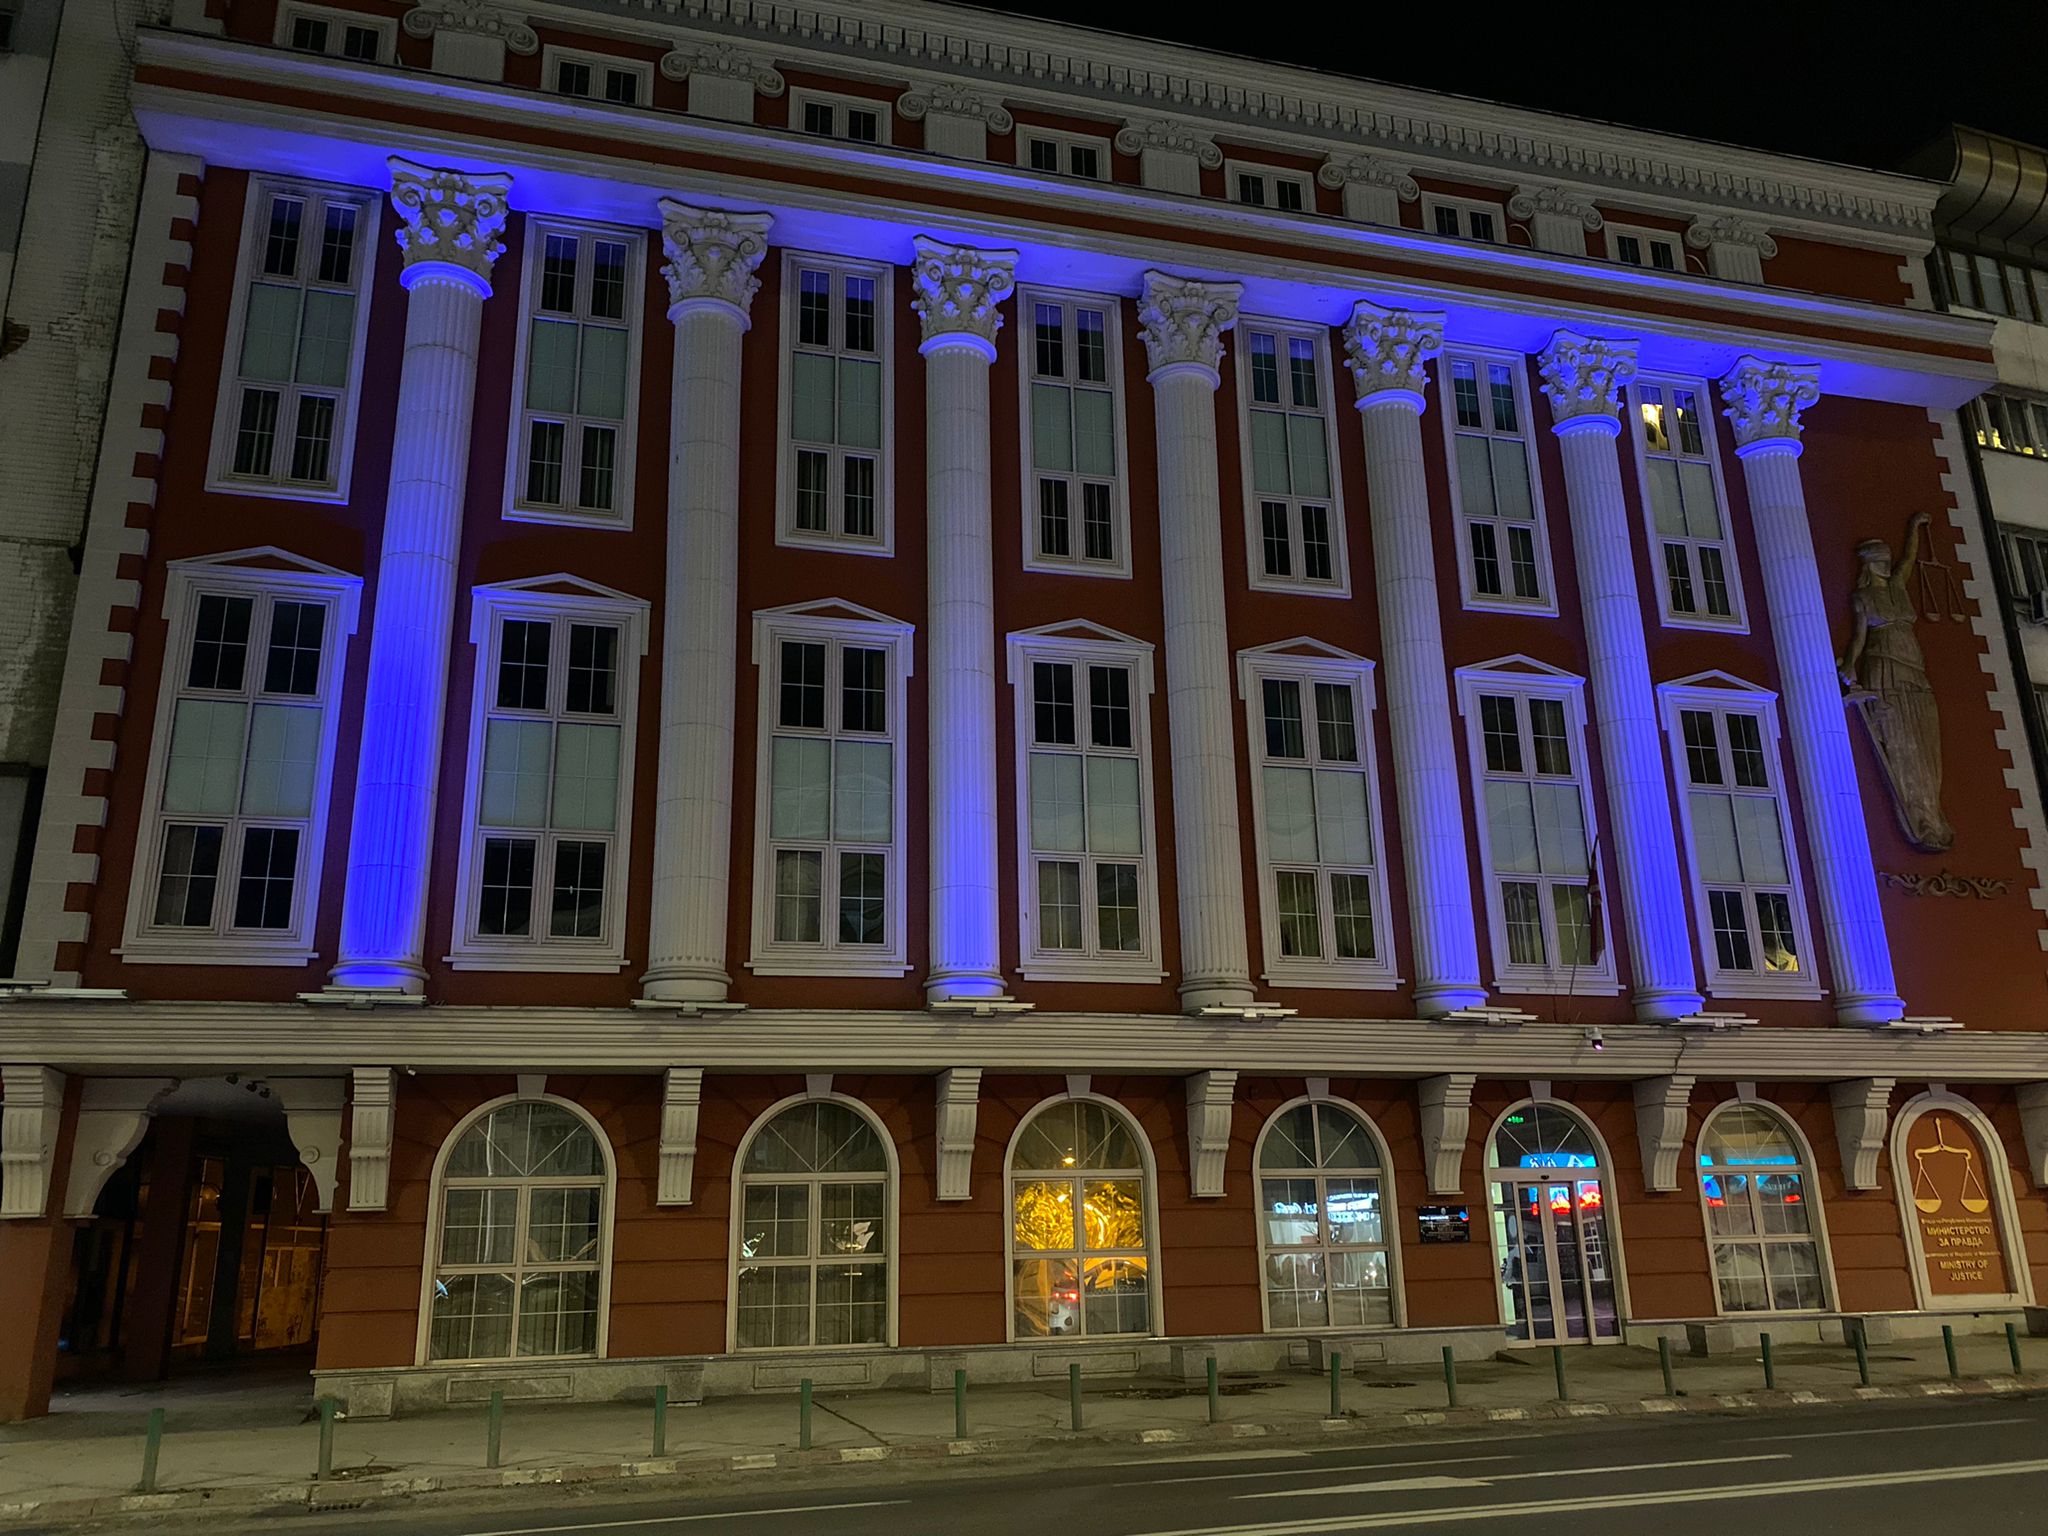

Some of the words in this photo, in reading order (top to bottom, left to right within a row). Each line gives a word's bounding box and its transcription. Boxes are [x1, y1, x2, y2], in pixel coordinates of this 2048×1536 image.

[1926, 1226, 1991, 1236] МИНИСТЕРСТВО
[1938, 1238, 1950, 1247] ЗА
[1950, 1237, 1984, 1248] ПРАВДА
[1940, 1260, 1976, 1270] MINISTRY
[1977, 1259, 1989, 1269] OF
[1950, 1271, 1984, 1281] JUSTICE
